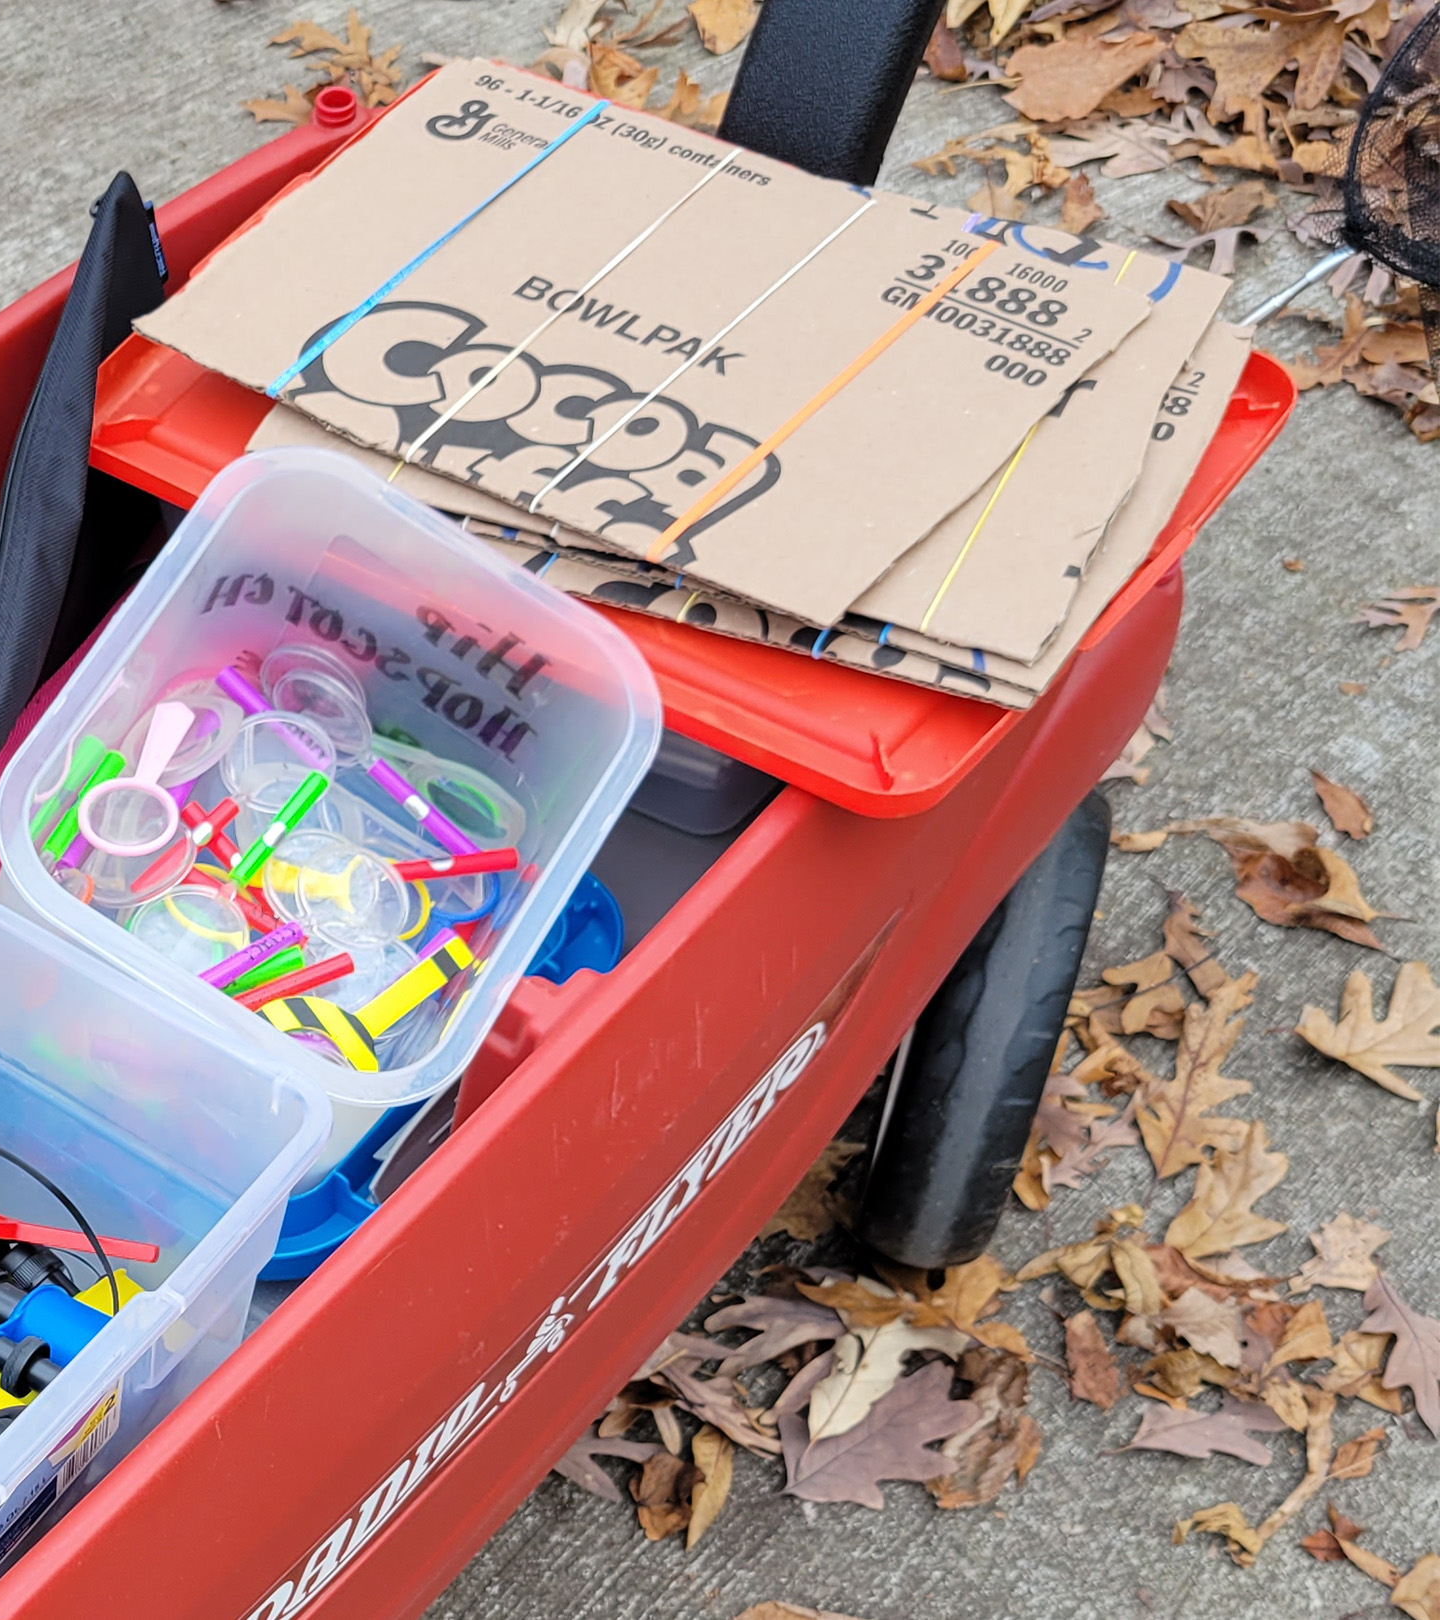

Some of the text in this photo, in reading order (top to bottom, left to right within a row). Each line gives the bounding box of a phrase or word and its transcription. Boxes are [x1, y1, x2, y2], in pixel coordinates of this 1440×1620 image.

[474, 74, 504, 91] 96
[515, 88, 582, 119] 1-1/16
[611, 121, 667, 151] (30g)
[477, 132, 517, 151] Mills
[1005, 262, 1069, 294] 16000
[513, 274, 747, 377] BOWLPAK
[1073, 328, 1093, 344] 2
[984, 354, 1048, 388] 000
[568, 1020, 828, 1313] FLYER
